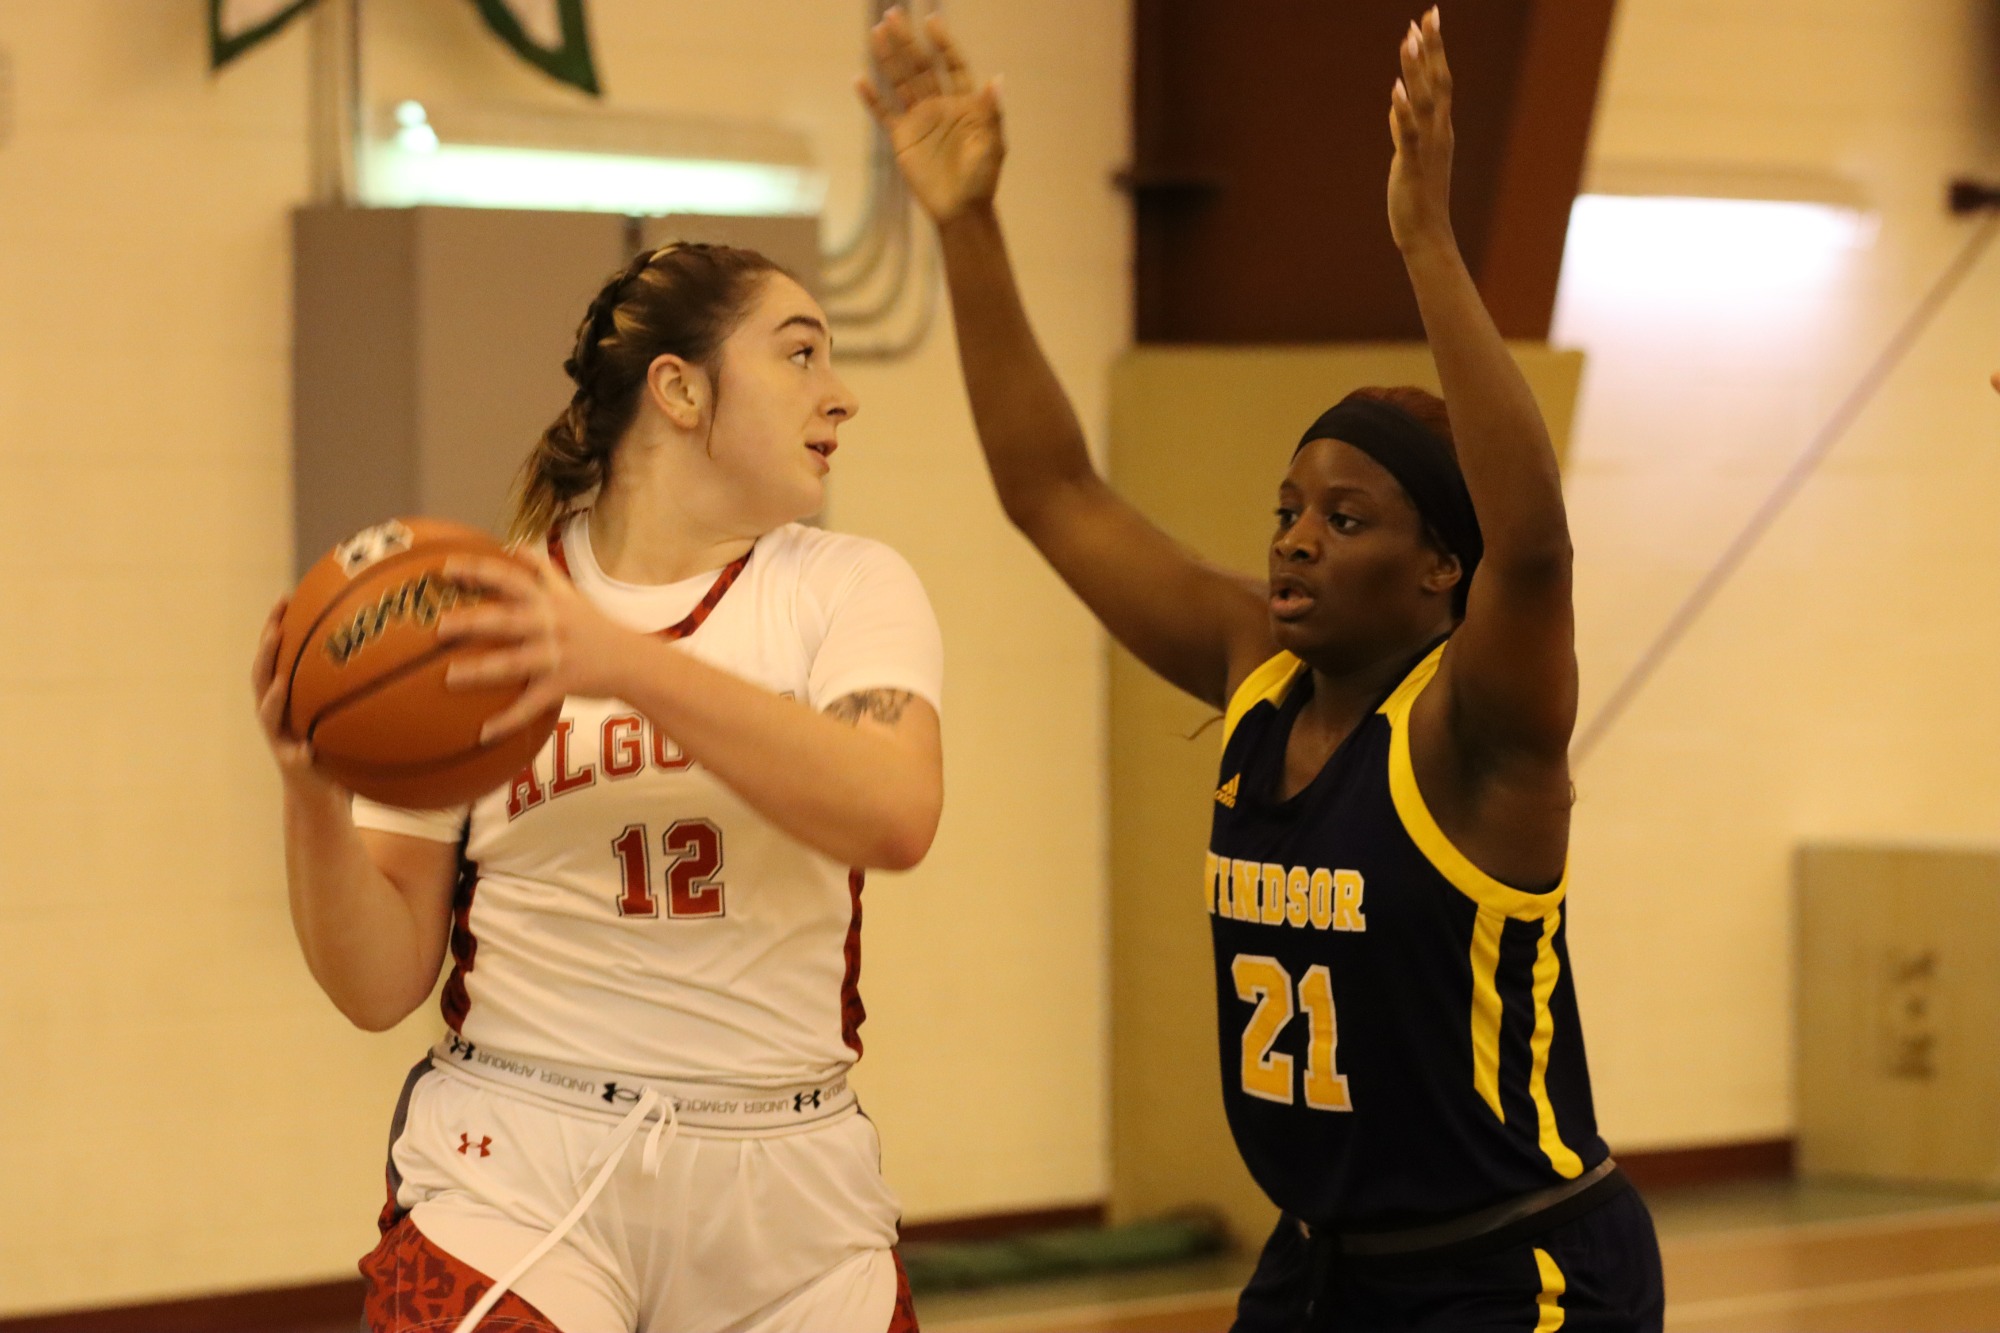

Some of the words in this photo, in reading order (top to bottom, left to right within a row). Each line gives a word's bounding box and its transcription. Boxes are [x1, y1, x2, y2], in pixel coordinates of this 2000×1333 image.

[505, 712, 697, 823] ALGO
[611, 817, 726, 920] 12
[477, 1049, 537, 1078] ARMOUR
[1231, 953, 1354, 1112] 21
[540, 1070, 595, 1095] UNDER
[743, 1099, 789, 1114] UNDER
